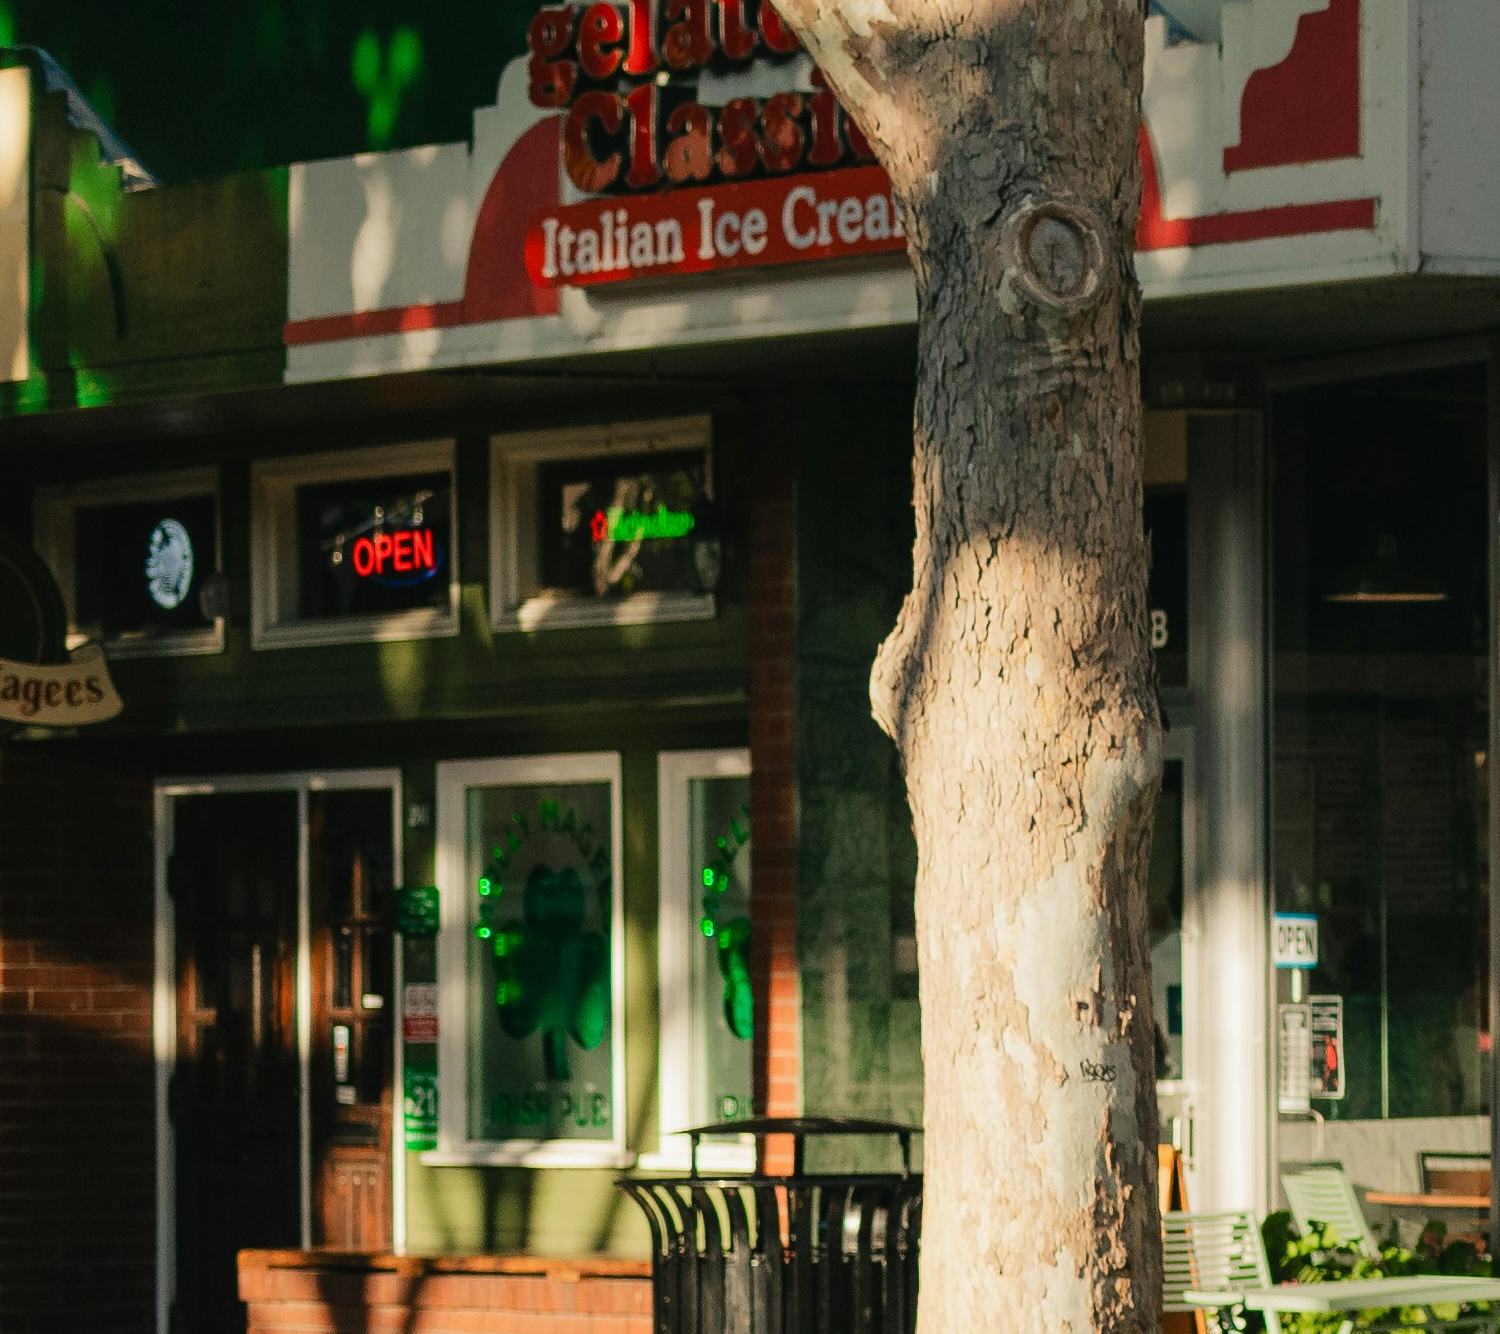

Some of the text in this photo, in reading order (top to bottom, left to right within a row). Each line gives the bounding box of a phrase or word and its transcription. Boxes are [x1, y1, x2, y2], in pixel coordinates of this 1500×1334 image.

[541, 186, 903, 278] Italian Ice Crea
[353, 529, 436, 577] OPEN
[0, 670, 104, 717] agees
[1278, 923, 1315, 956] OPEN
